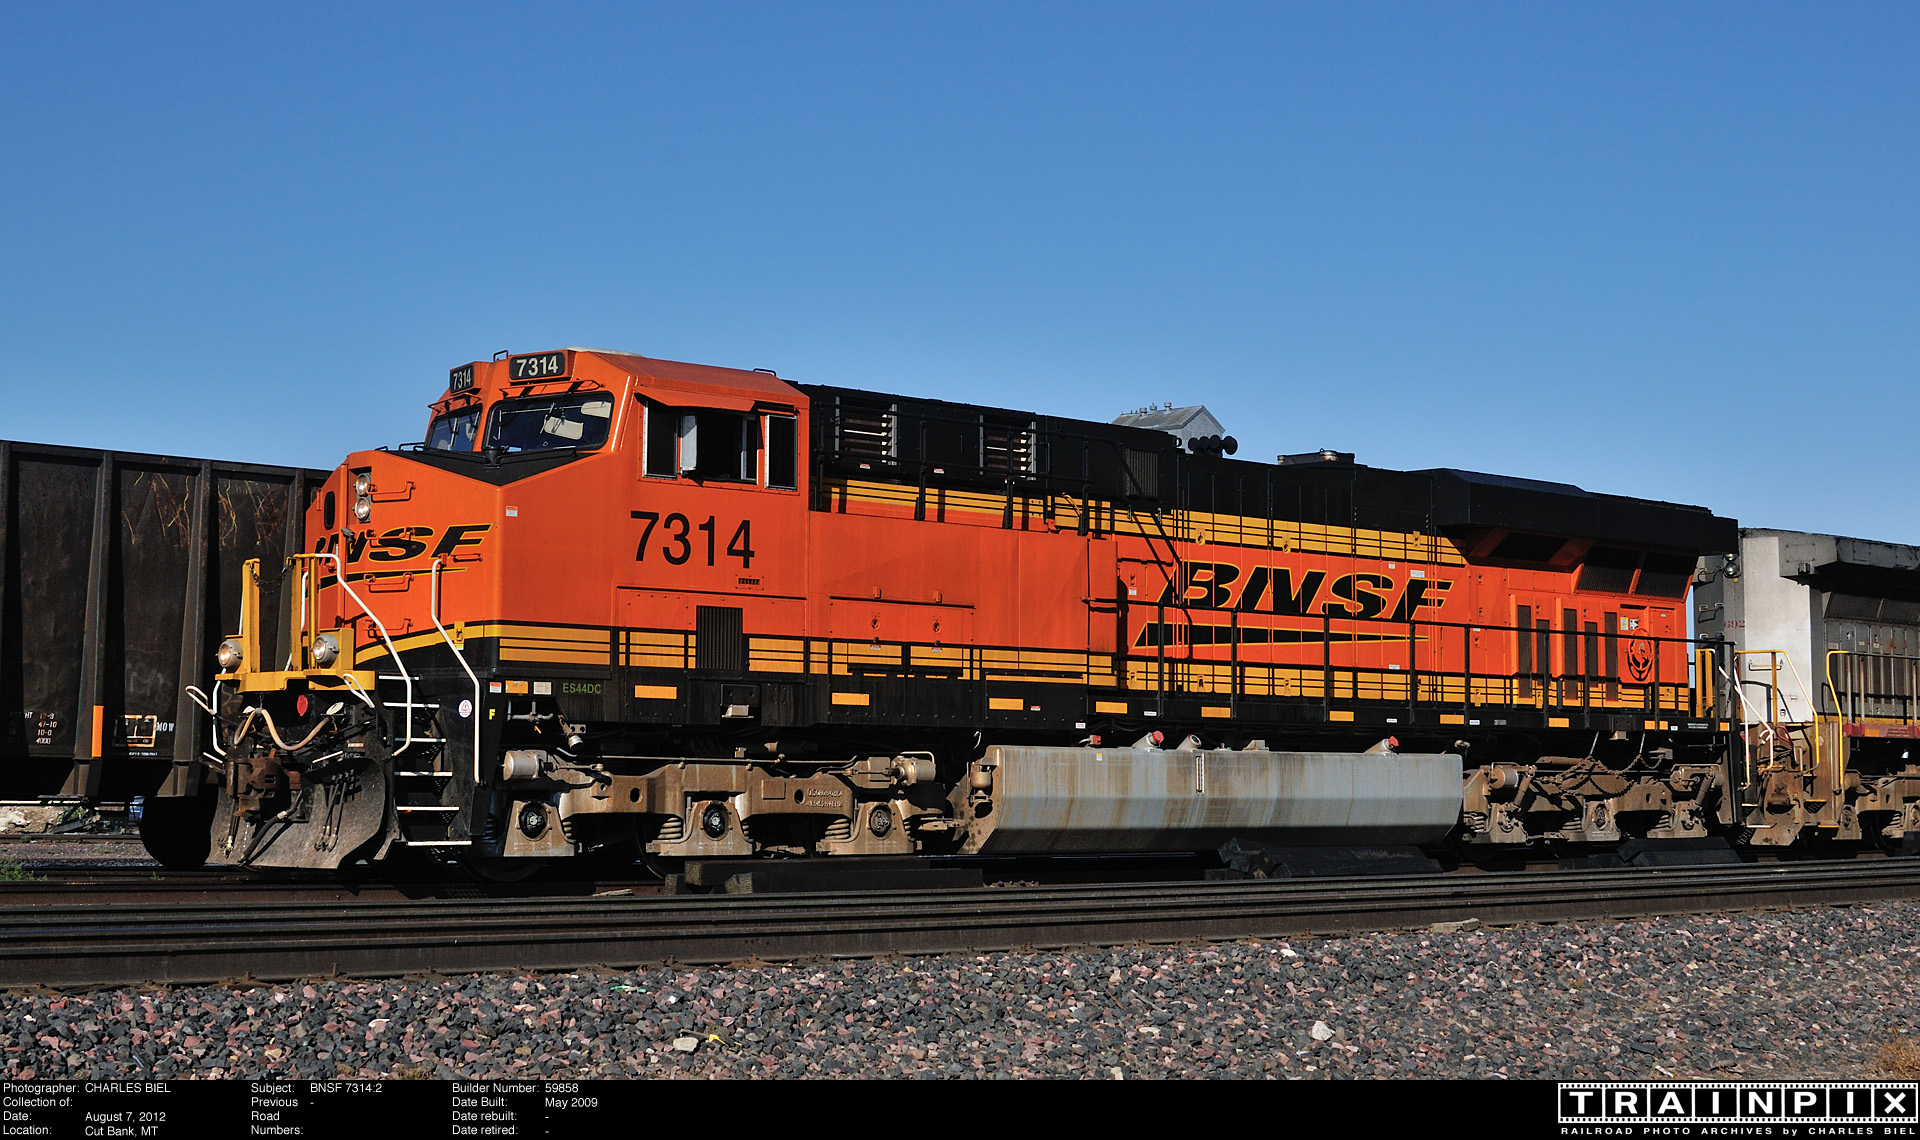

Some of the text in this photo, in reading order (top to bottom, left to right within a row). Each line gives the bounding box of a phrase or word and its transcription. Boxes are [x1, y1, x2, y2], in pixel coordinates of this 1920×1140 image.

[516, 355, 559, 377] 7314
[453, 368, 472, 390] 7314
[630, 510, 755, 569] 7314
[1156, 559, 1455, 622] BNSF
[562, 682, 602, 694] ES44DC
[488, 708, 496, 721] F
